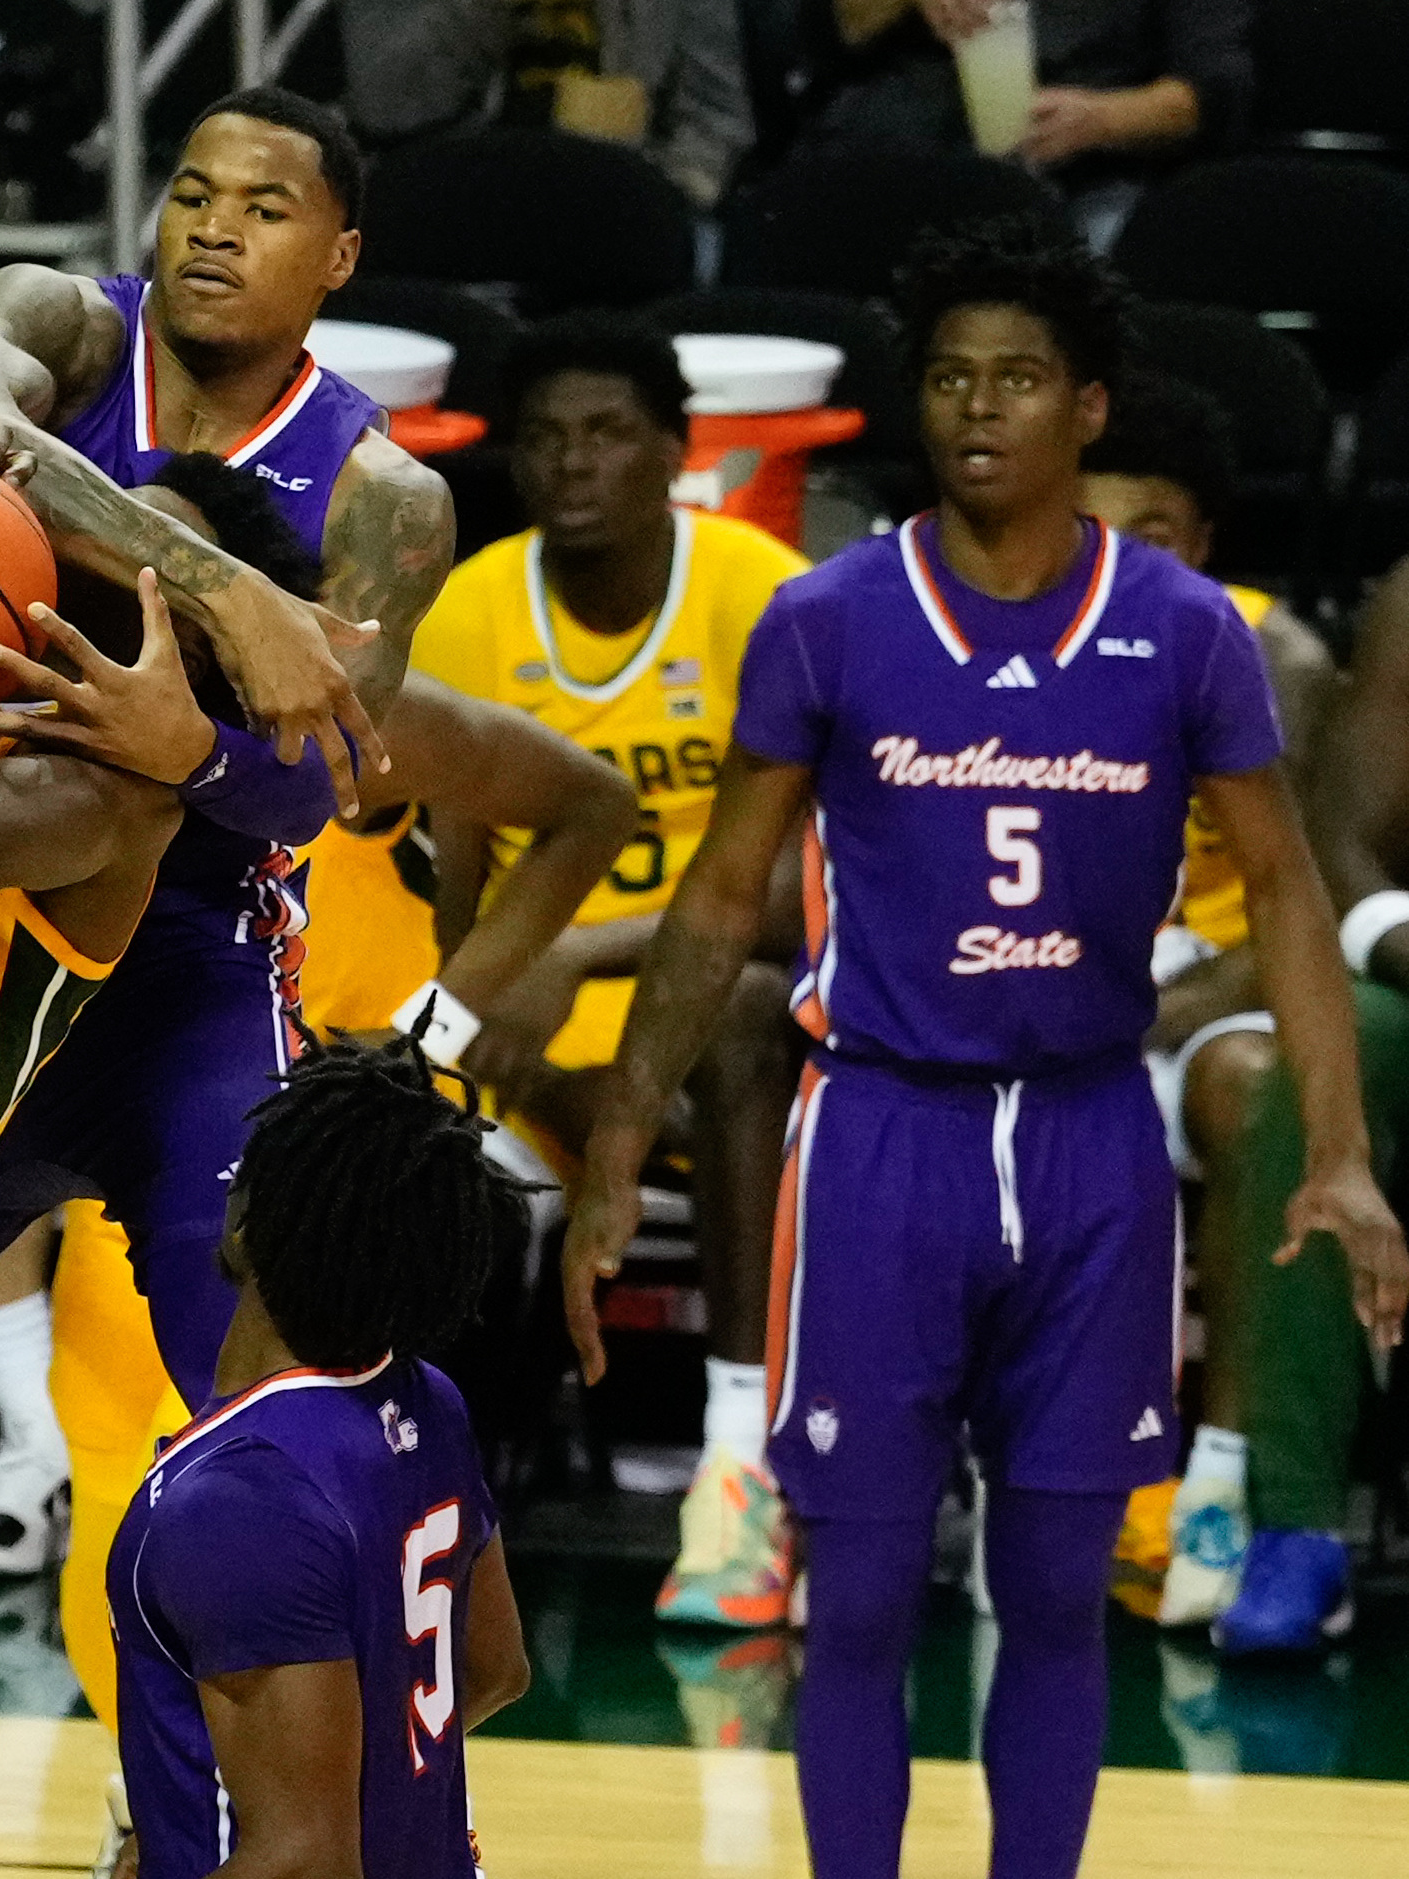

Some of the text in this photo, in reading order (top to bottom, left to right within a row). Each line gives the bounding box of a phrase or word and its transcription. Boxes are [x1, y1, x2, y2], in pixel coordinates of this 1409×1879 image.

[870, 734, 1152, 793] Northwestern
[986, 804, 1043, 907] 5
[948, 924, 1083, 975] State
[402, 1497, 461, 1777] 5
